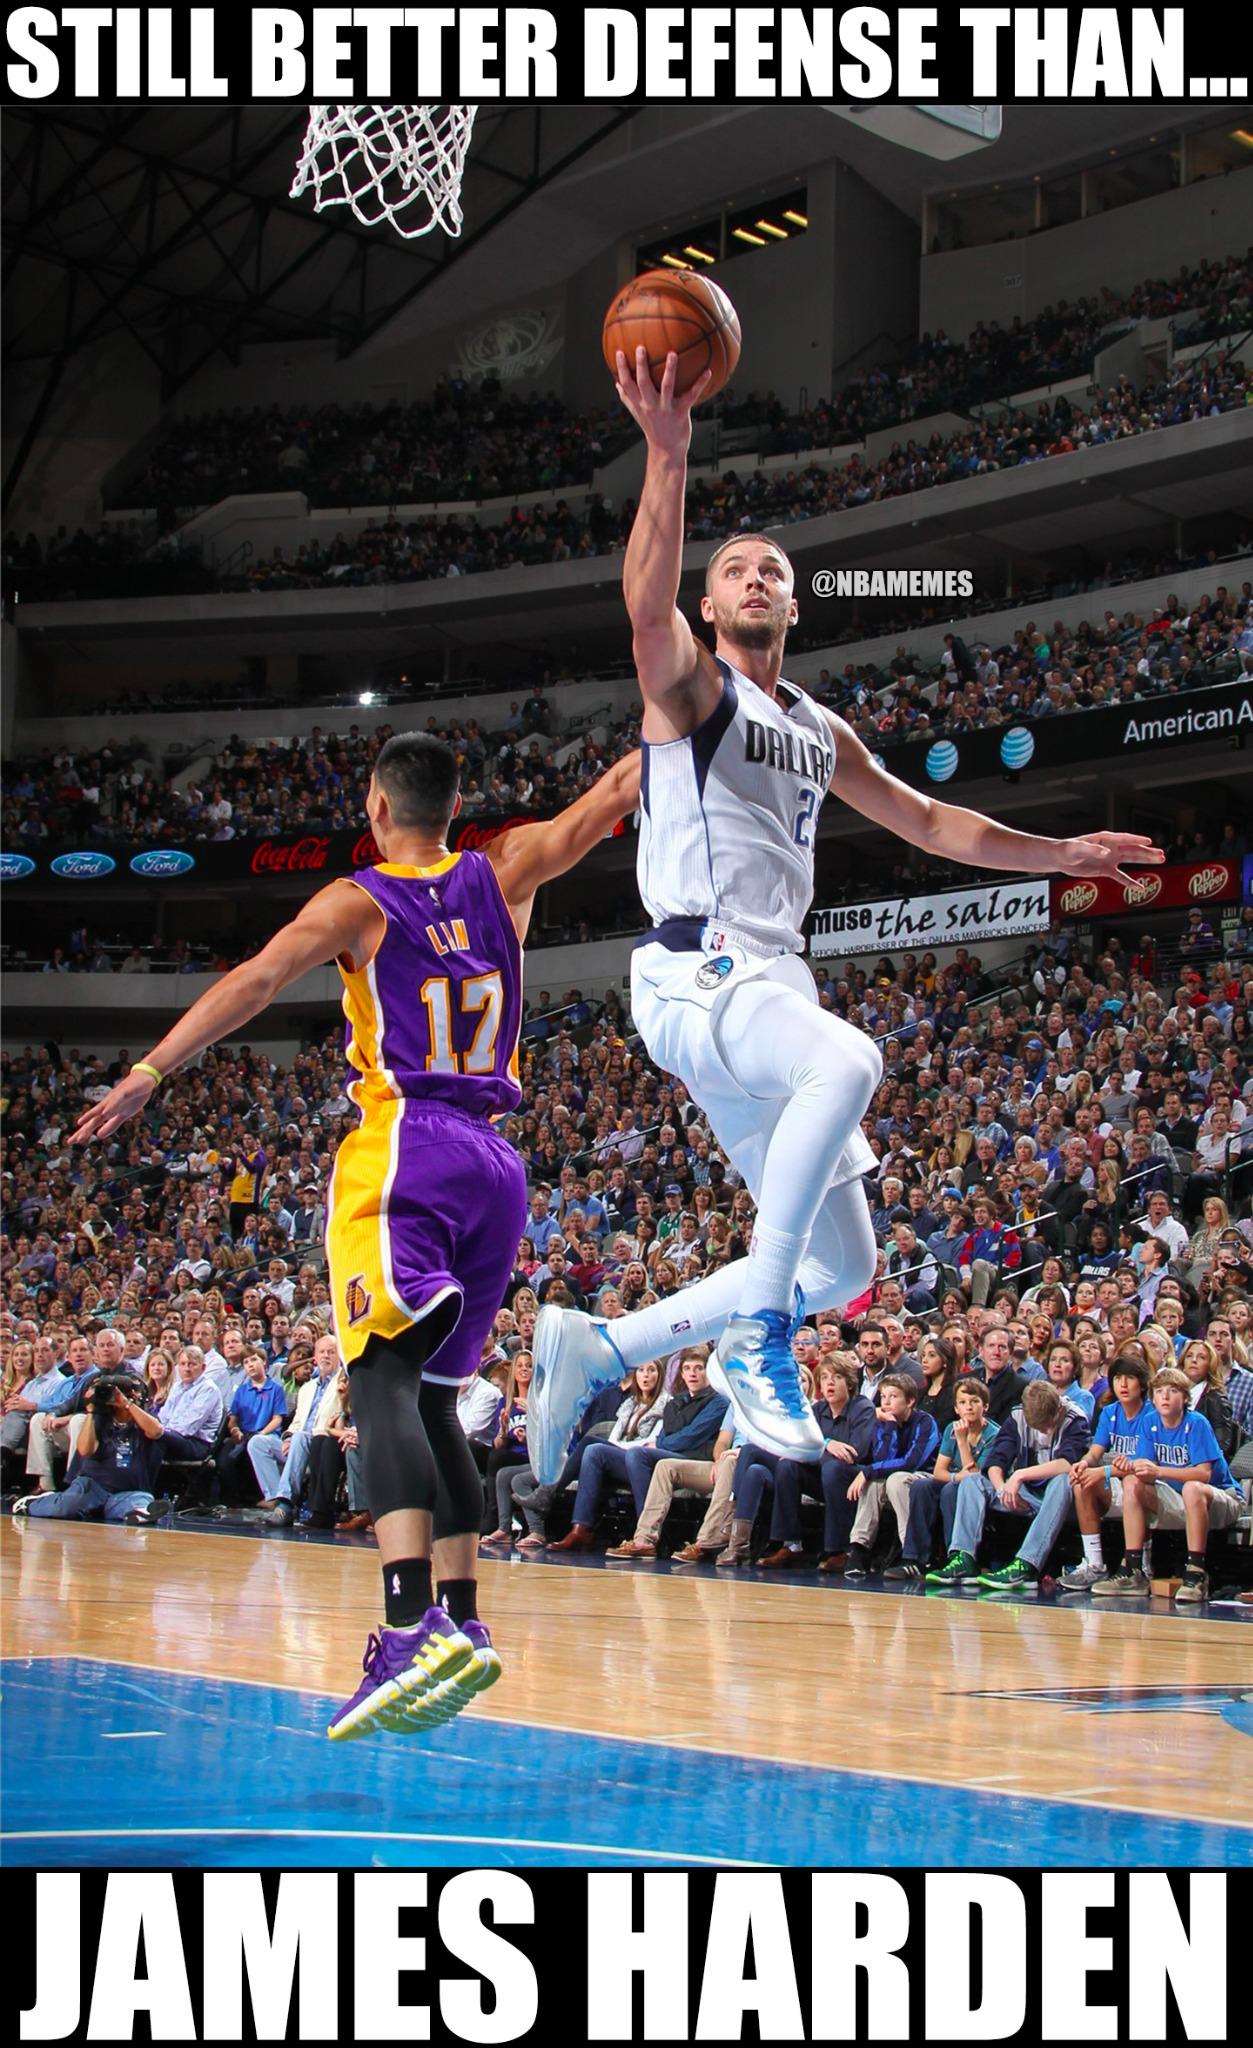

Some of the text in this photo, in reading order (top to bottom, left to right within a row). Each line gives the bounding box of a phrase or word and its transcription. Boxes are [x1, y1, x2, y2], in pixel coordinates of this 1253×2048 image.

[1123, 707, 1234, 744] American
[0, 856, 22, 875] ord
[62, 855, 101, 874] Ford
[142, 853, 181, 873] Ford
[1189, 872, 1225, 897] Pepper
[1061, 889, 1096, 912] Pepper
[876, 897, 936, 940] the
[945, 889, 1050, 930] salon
[425, 918, 471, 957] LIN
[898, 938, 909, 948] OF
[912, 936, 927, 947] THE
[929, 932, 959, 945] DALLAS
[962, 927, 1008, 942] MAVERICKS
[1010, 922, 1051, 936] DANCERS
[420, 968, 504, 1075] 17
[1081, 1264, 1111, 1276] DALLAS
